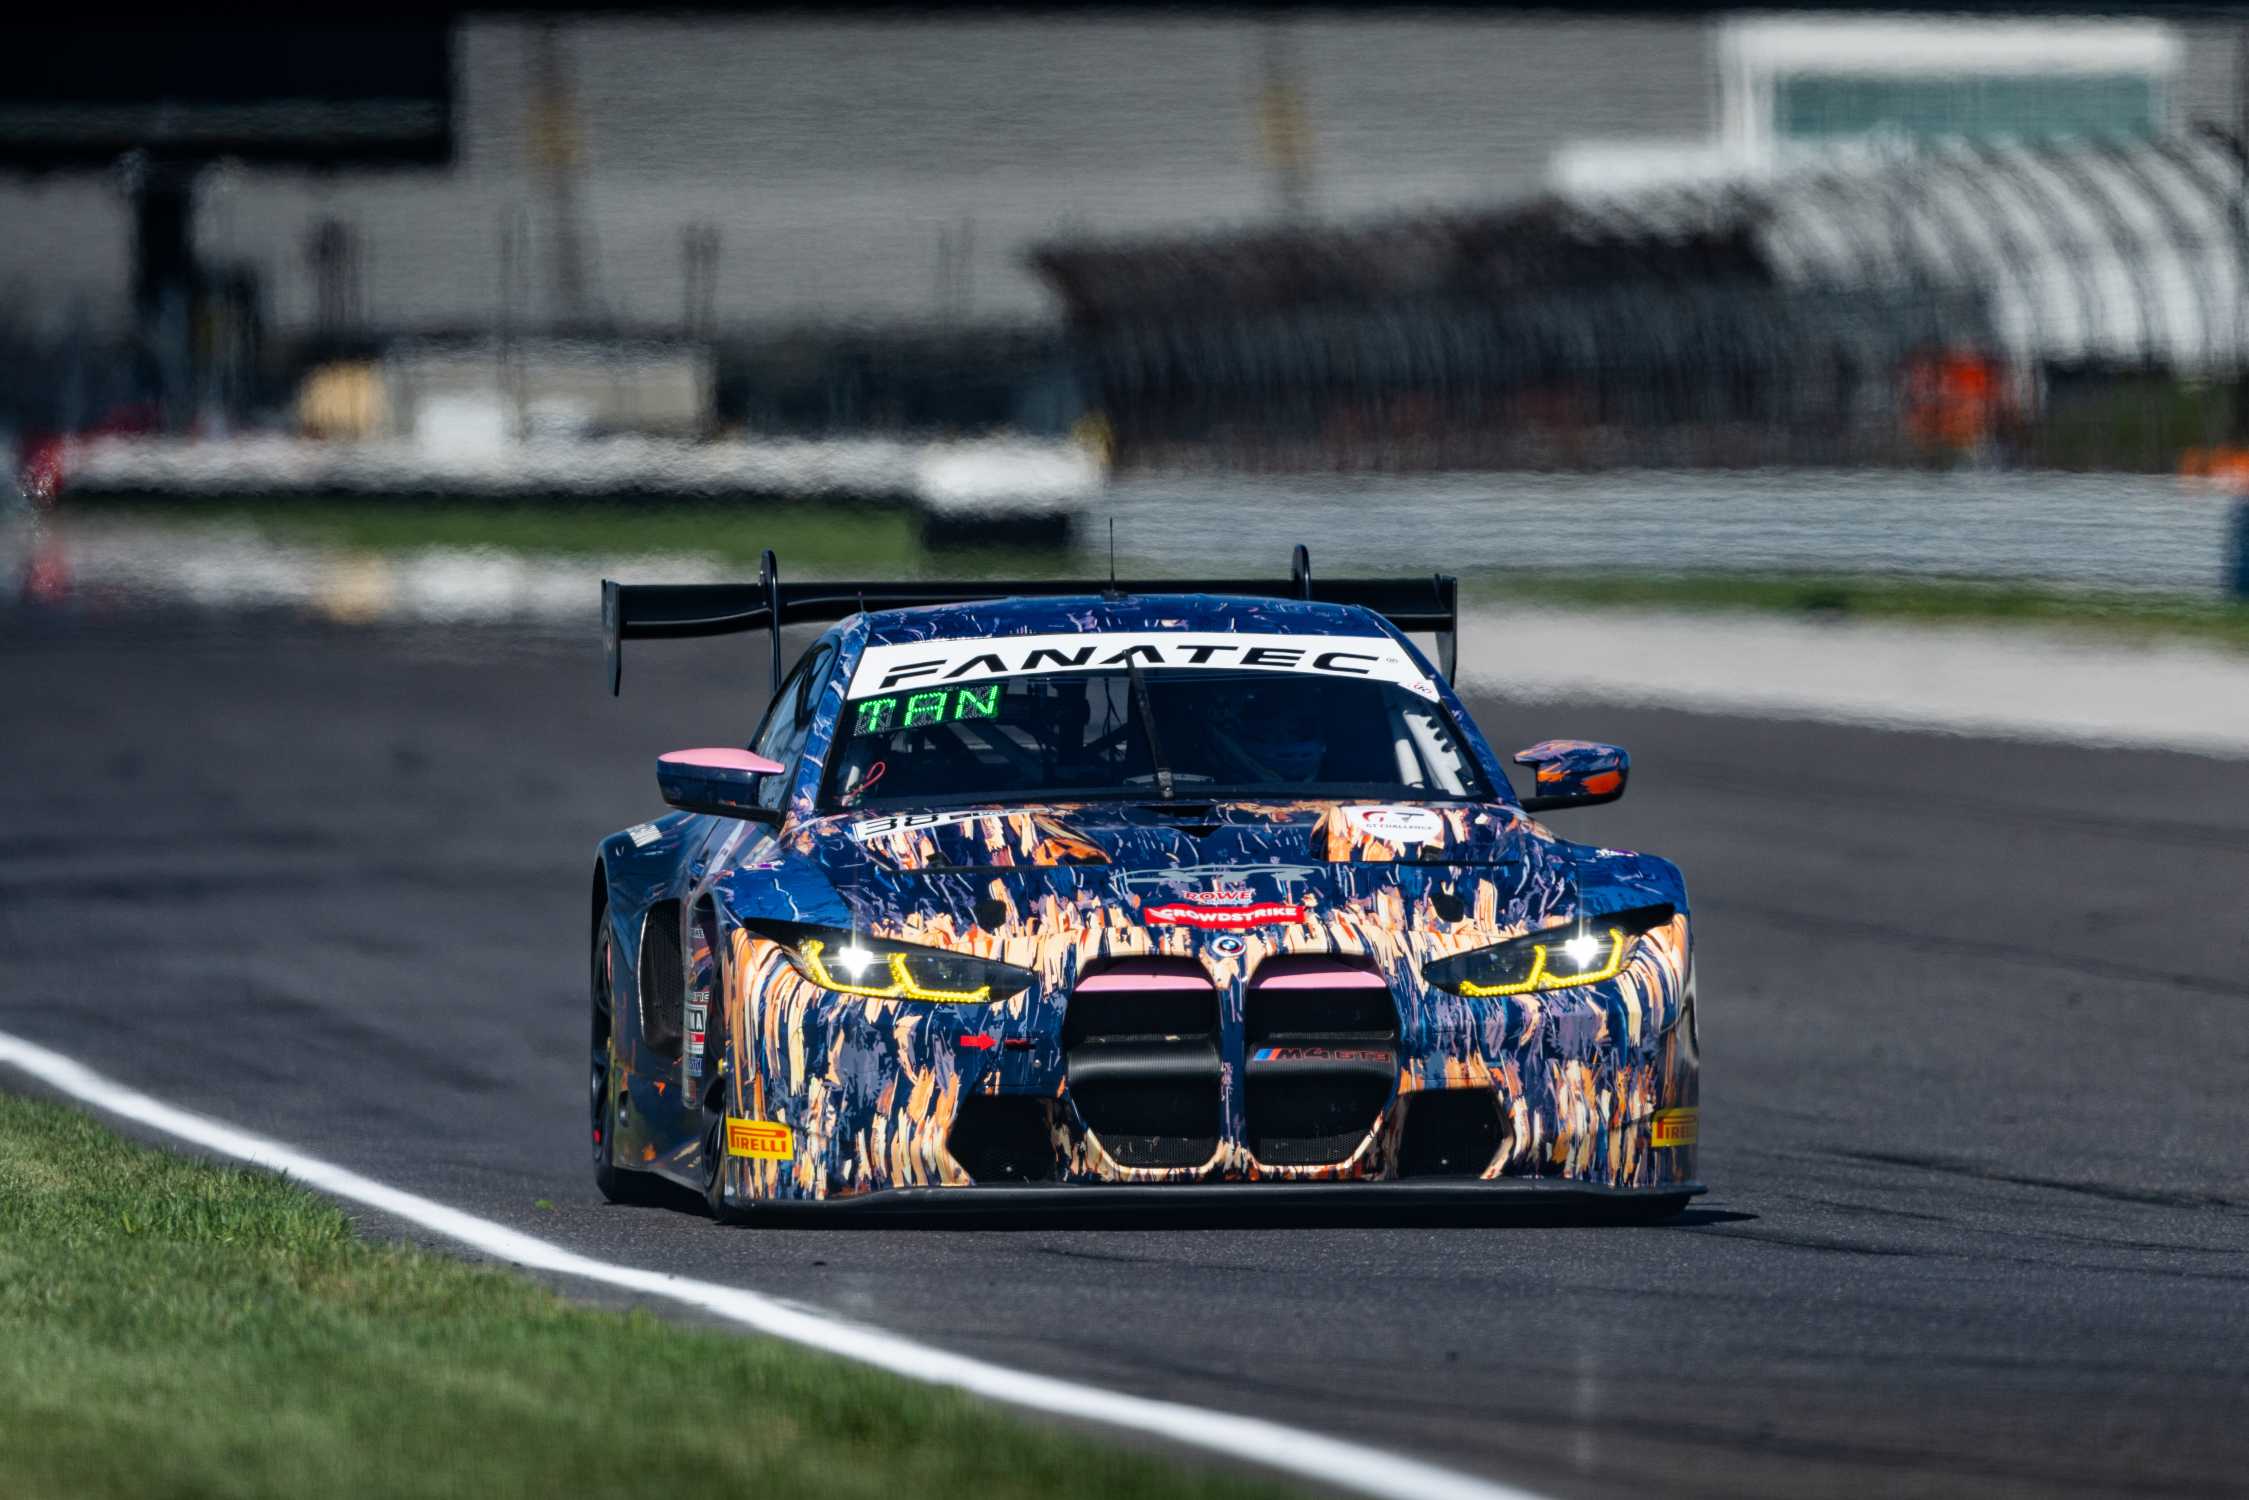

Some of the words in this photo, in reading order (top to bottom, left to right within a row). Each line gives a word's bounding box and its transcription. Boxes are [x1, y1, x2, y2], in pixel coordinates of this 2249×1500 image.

[879, 645, 1379, 689] FANATEC
[858, 684, 999, 733] TAN
[1184, 891, 1252, 901] ROWE
[1160, 907, 1298, 923] CROWDSTRIKE
[1280, 1048, 1330, 1060] M4
[730, 1125, 787, 1153] PIRELLI
